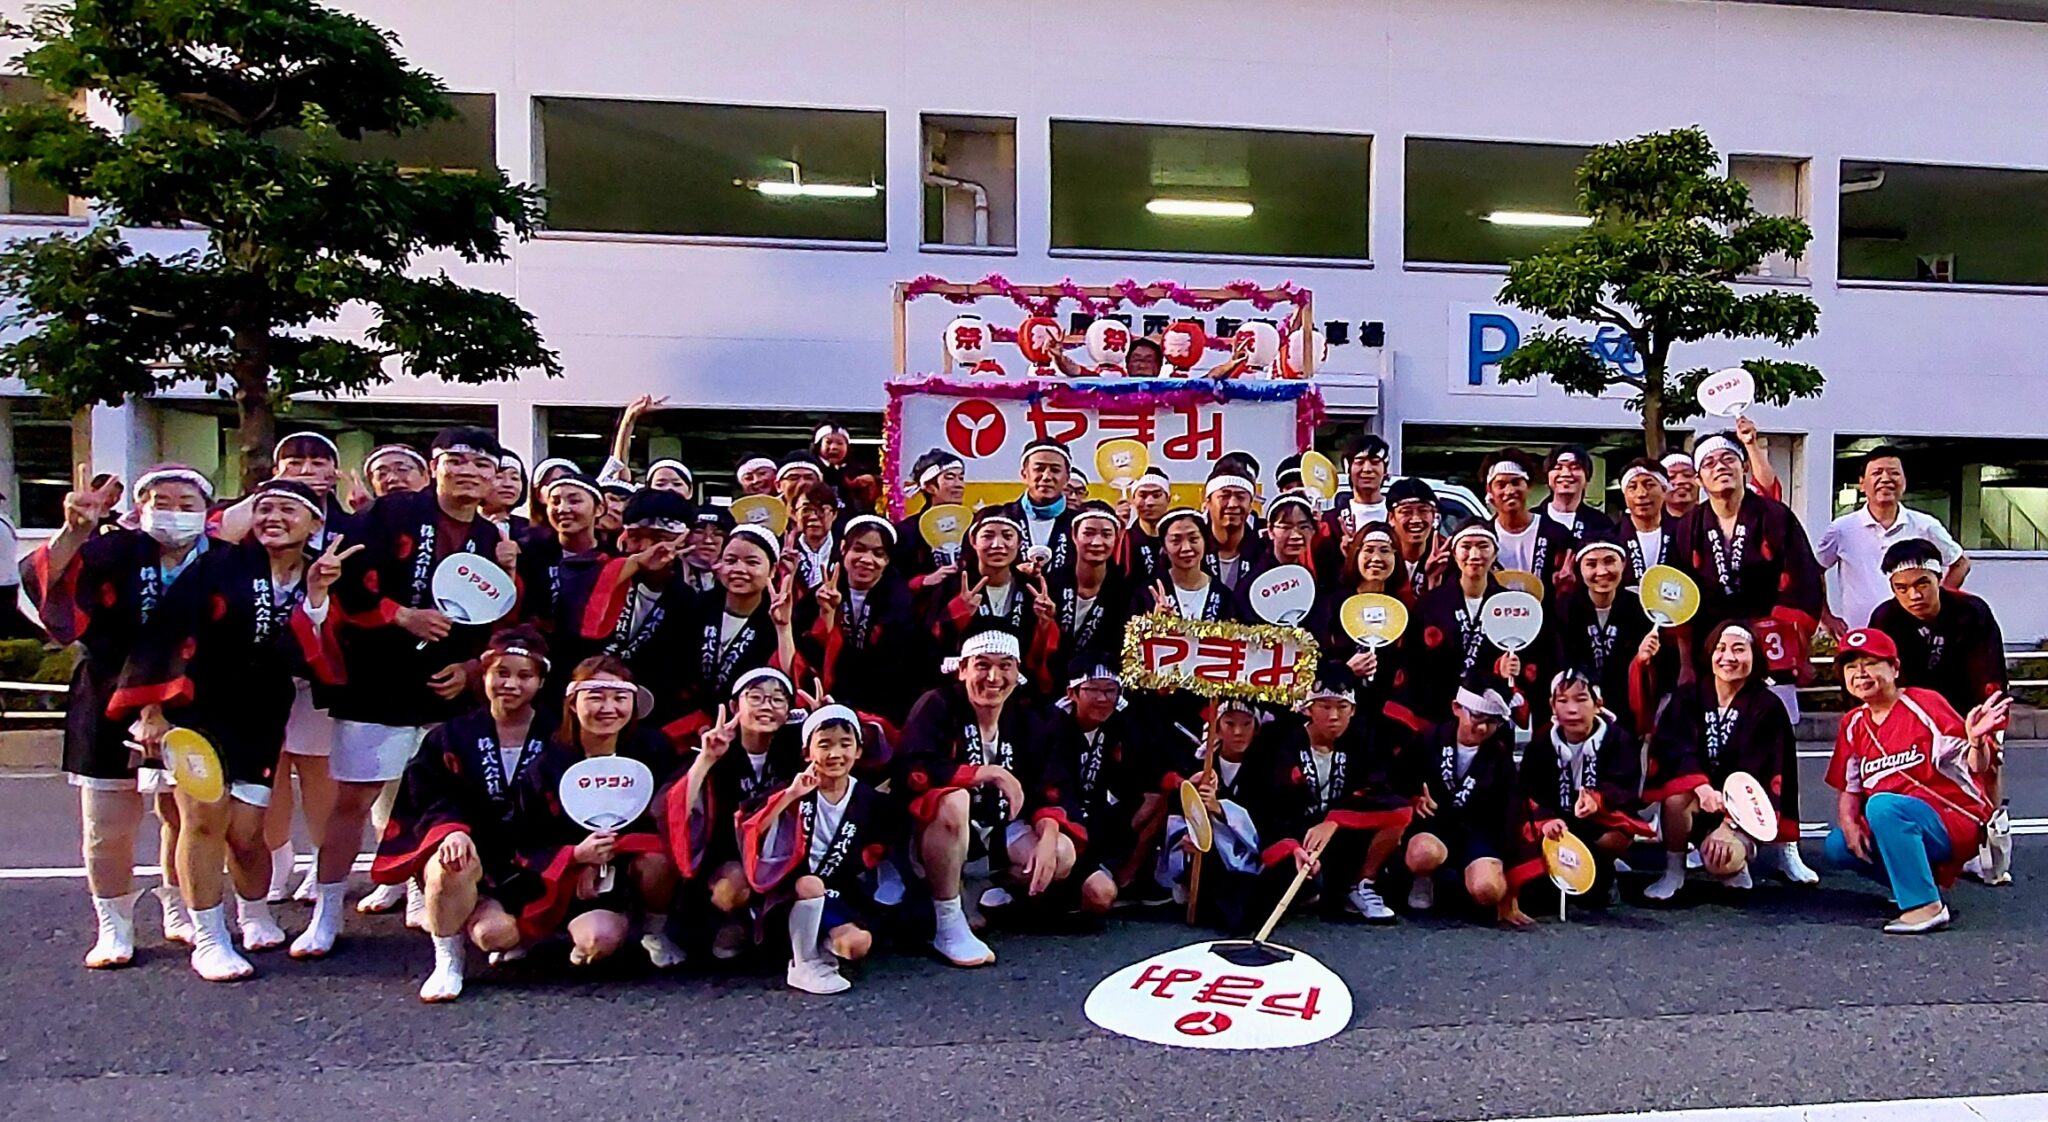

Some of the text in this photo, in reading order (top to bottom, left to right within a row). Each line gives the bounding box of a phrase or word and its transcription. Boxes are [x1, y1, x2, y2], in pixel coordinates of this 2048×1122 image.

[955, 326, 983, 351] 祭
[1102, 327, 1128, 352] 祭
[1468, 313, 1520, 385] P
[1027, 400, 1222, 460] やまみ
[468, 572, 500, 600] やまみ
[1271, 579, 1300, 594] やまみ
[1504, 607, 1530, 617] やまみ
[1140, 630, 1303, 687] やまみ
[1765, 632, 1785, 661] 3
[595, 776, 634, 788] やまみ
[1130, 965, 1321, 1020] やまみ
